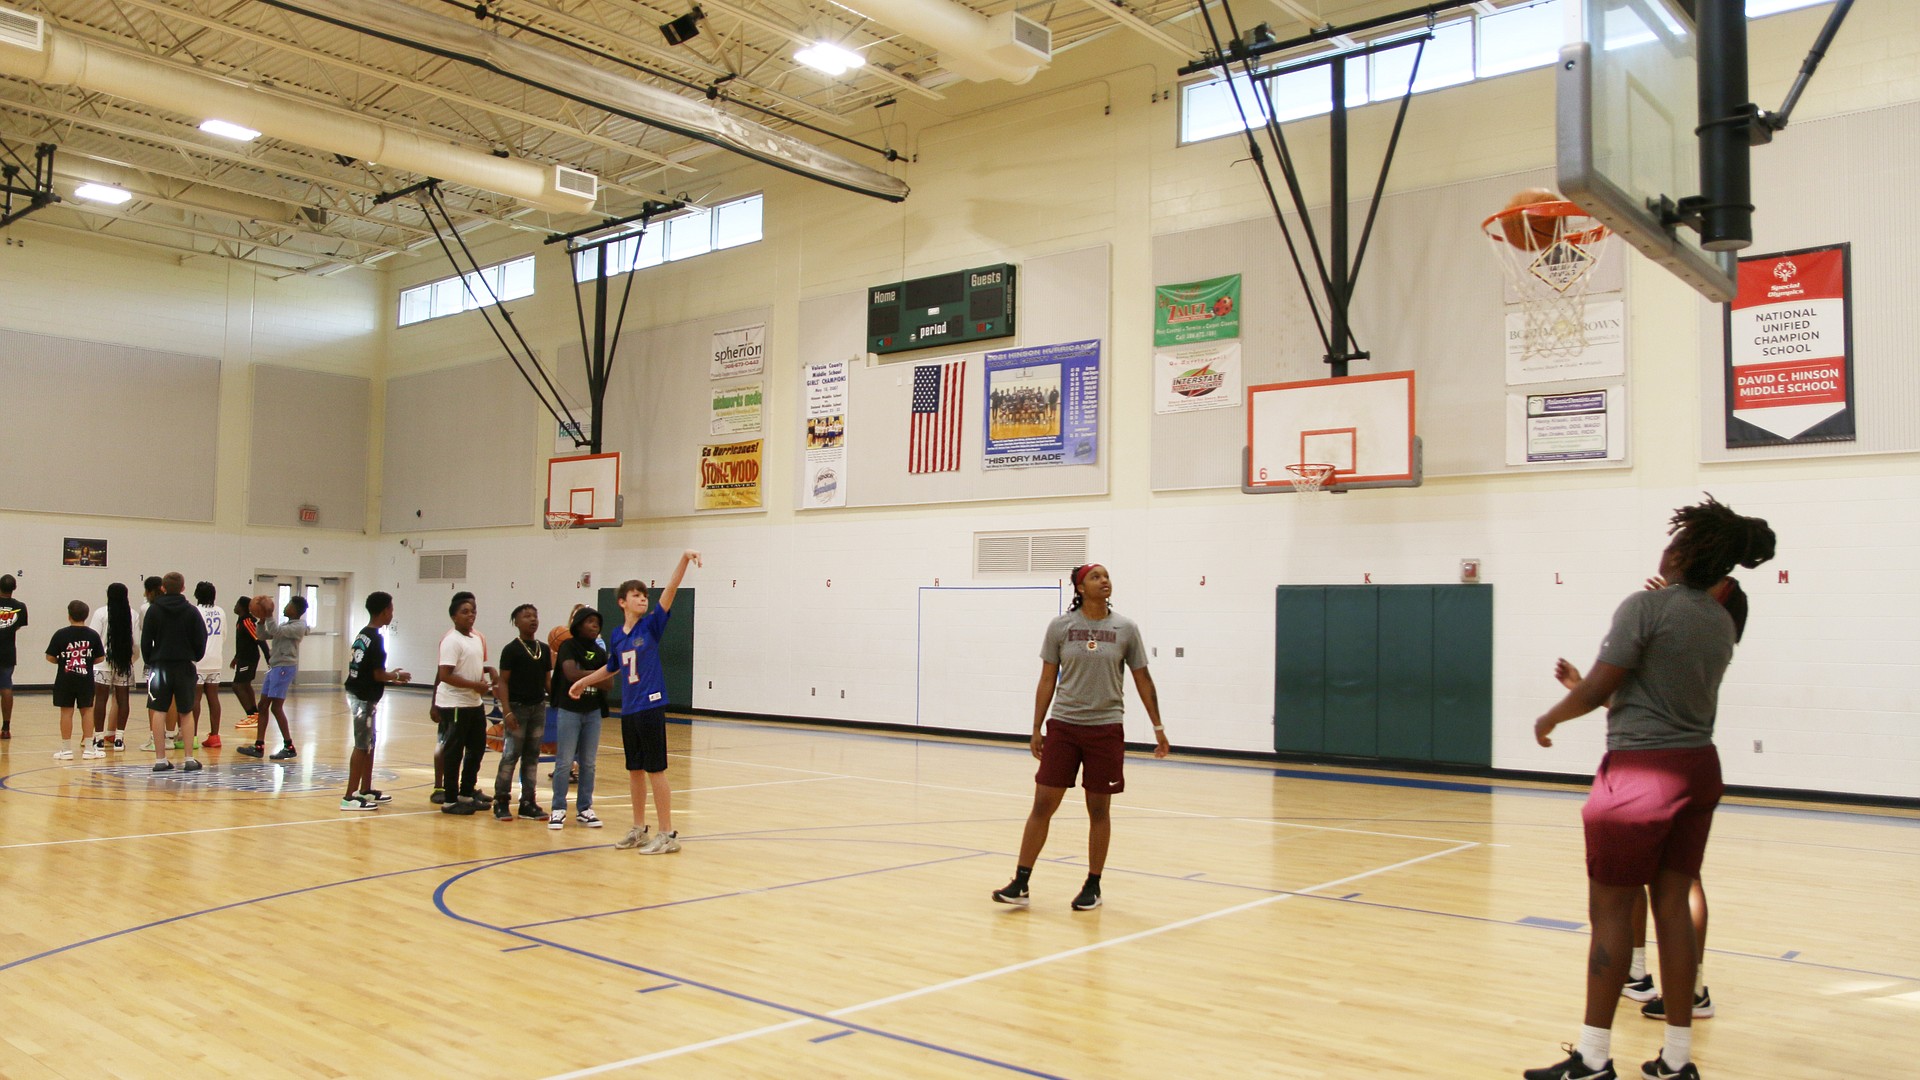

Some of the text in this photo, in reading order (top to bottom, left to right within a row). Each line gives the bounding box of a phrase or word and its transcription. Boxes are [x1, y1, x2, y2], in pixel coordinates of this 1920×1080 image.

[971, 271, 1001, 287] Guests
[1767, 288, 1804, 298] Olympics
[1770, 282, 1800, 291] Special
[874, 290, 896, 304] Home
[1755, 308, 1817, 322] NATIONAL
[920, 321, 947, 339] period
[1762, 320, 1810, 333] UNIFIED
[1754, 331, 1820, 345] CHAMPION
[714, 344, 762, 364] spherion
[1008, 349, 1041, 359] HINSON
[1763, 344, 1812, 356] SCHOOL
[1173, 373, 1224, 385] INTERSTATE
[1737, 368, 1839, 386] DAVID C. HINSON
[1740, 380, 1837, 397] MIDDLE SCHOOL
[712, 442, 759, 457] Hurricanes!
[984, 452, 1066, 465] "HISTORY MADE"
[1259, 467, 1268, 480] 6
[17, 569, 23, 578] 2
[1363, 572, 1372, 584] K
[1555, 572, 1564, 584] L
[1777, 570, 1789, 584] M
[732, 579, 737, 588] F
[1199, 575, 1206, 586] J
[206, 617, 221, 636] 32
[66, 640, 90, 650] ANTI
[61, 648, 93, 658] STOCK
[621, 649, 640, 685] 7
